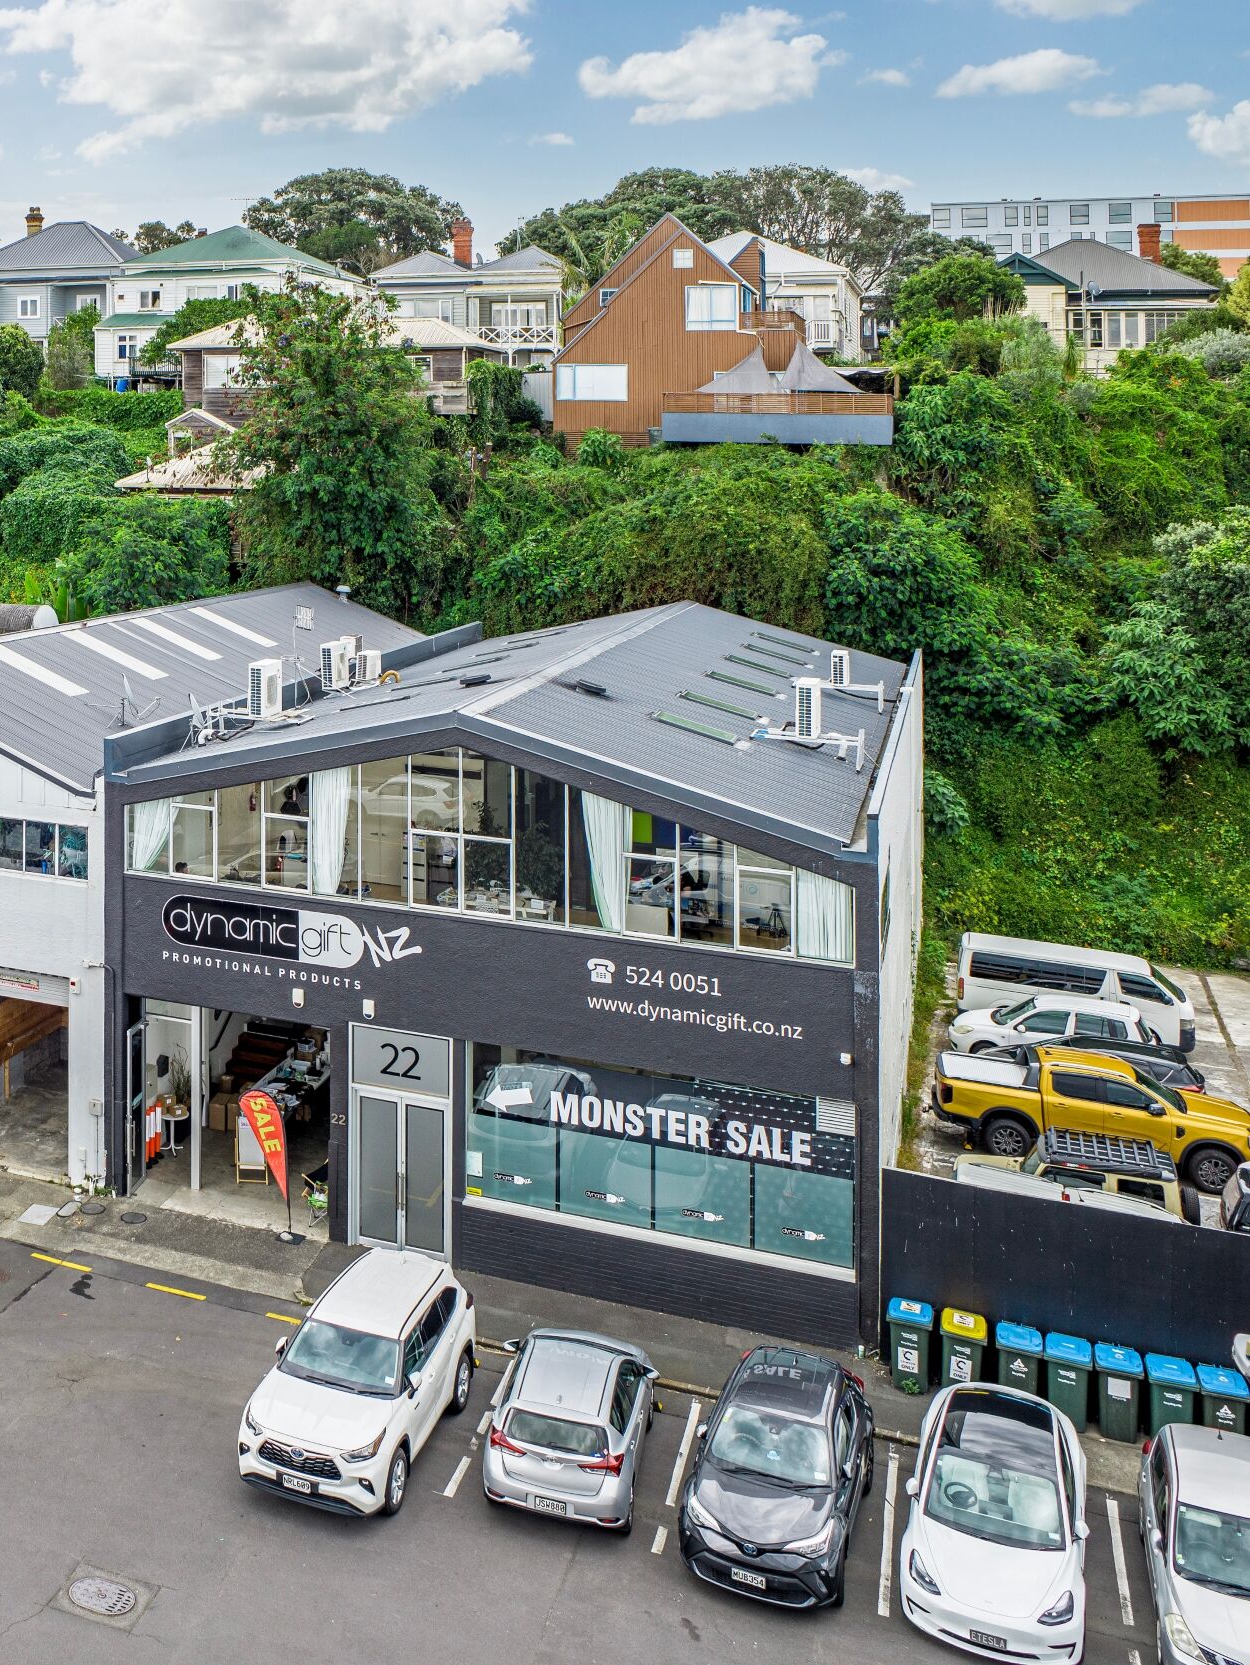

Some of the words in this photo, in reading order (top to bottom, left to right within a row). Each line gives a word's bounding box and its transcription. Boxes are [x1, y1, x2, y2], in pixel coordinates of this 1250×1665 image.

[170, 902, 297, 948] dynamic
[301, 922, 352, 958] gift
[361, 923, 423, 968] NZ
[162, 950, 272, 977] PROMOTIONAL
[278, 967, 362, 990] PRODUCTS
[625, 965, 664, 989] 524
[669, 972, 723, 997] 0051
[587, 996, 804, 1040] www.dynamicgift.co.nz
[380, 1042, 422, 1081] 22
[250, 1098, 282, 1153] SALE
[331, 1113, 346, 1126] 22
[550, 1090, 711, 1150] MONSTER
[726, 1119, 812, 1166] SALE
[733, 1570, 764, 1587] MUB354
[971, 1631, 1005, 1649] ETESLA
